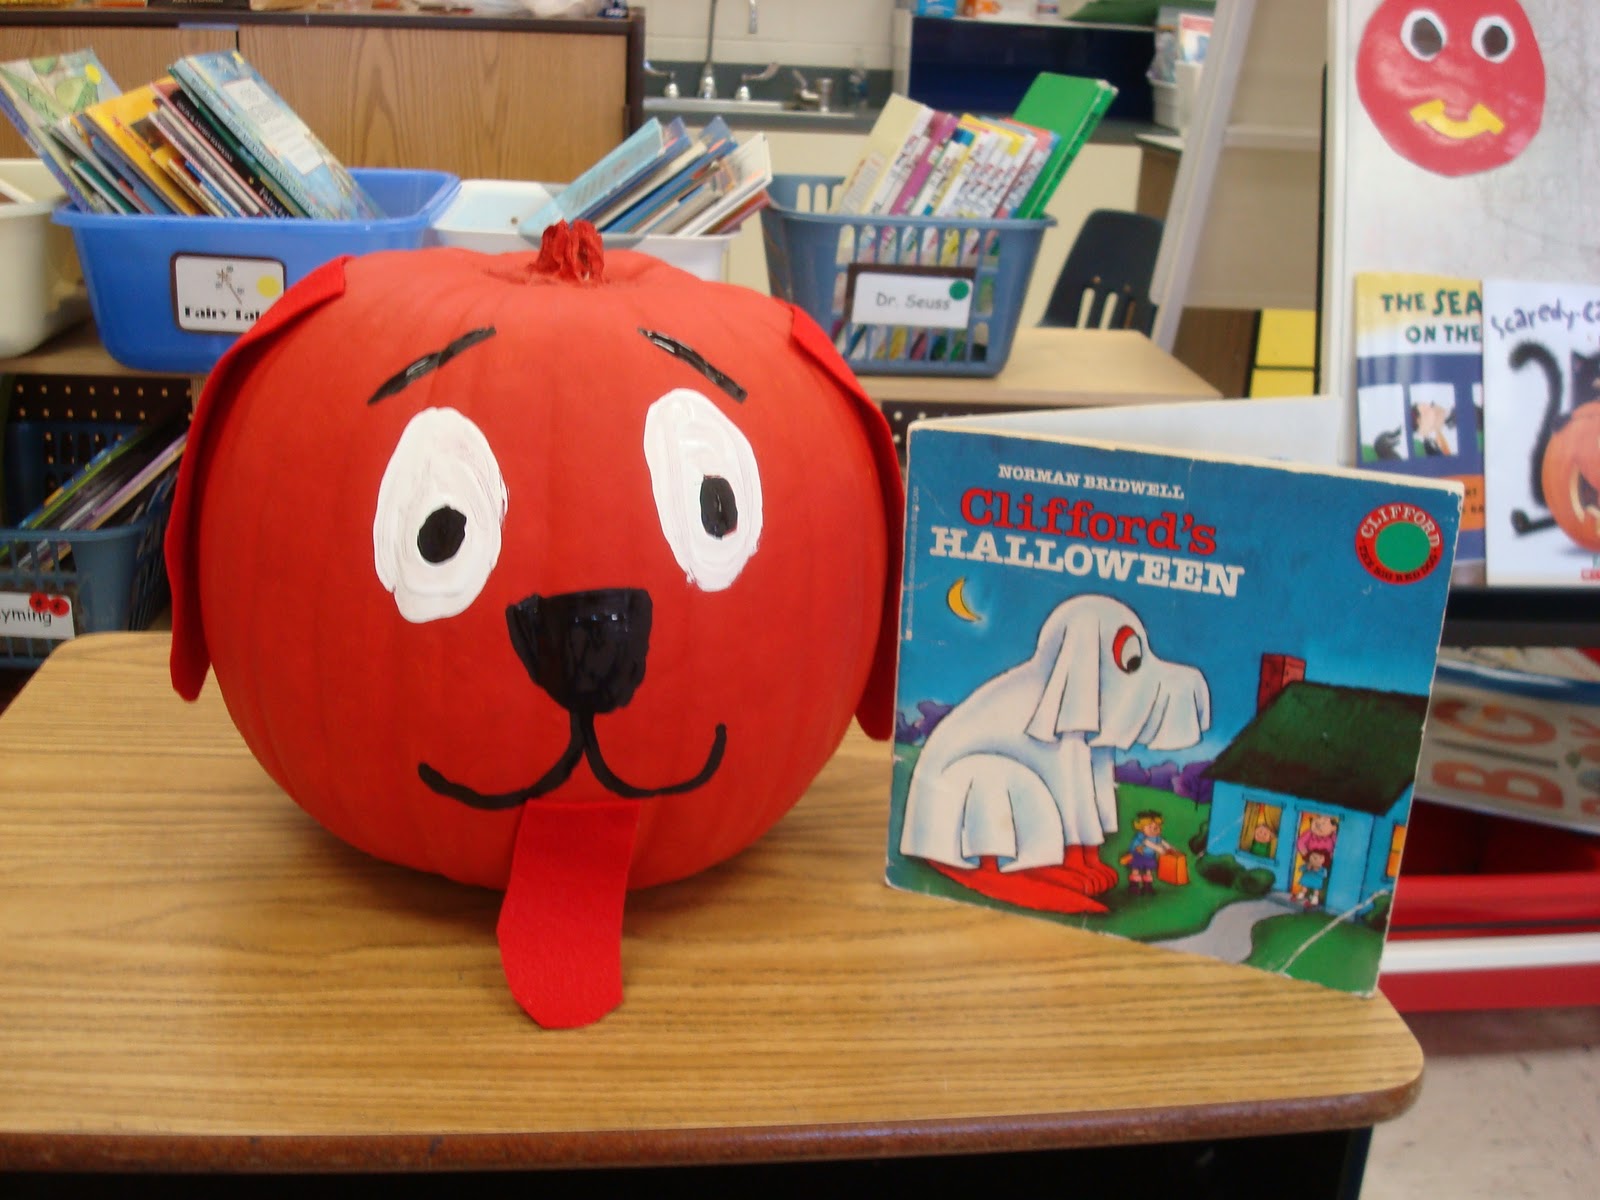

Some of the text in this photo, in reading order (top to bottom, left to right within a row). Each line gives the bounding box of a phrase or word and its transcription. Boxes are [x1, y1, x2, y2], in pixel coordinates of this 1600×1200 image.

[904, 294, 950, 311] Seuss
[1381, 289, 1482, 316] THE SEA
[1405, 325, 1481, 343] ON THE
[998, 464, 1185, 499] NORMAN BRIDWELL
[960, 487, 1217, 555] Clifford's
[1360, 504, 1440, 547] CLIFFORD
[929, 525, 1246, 598] HALLOWEEN
